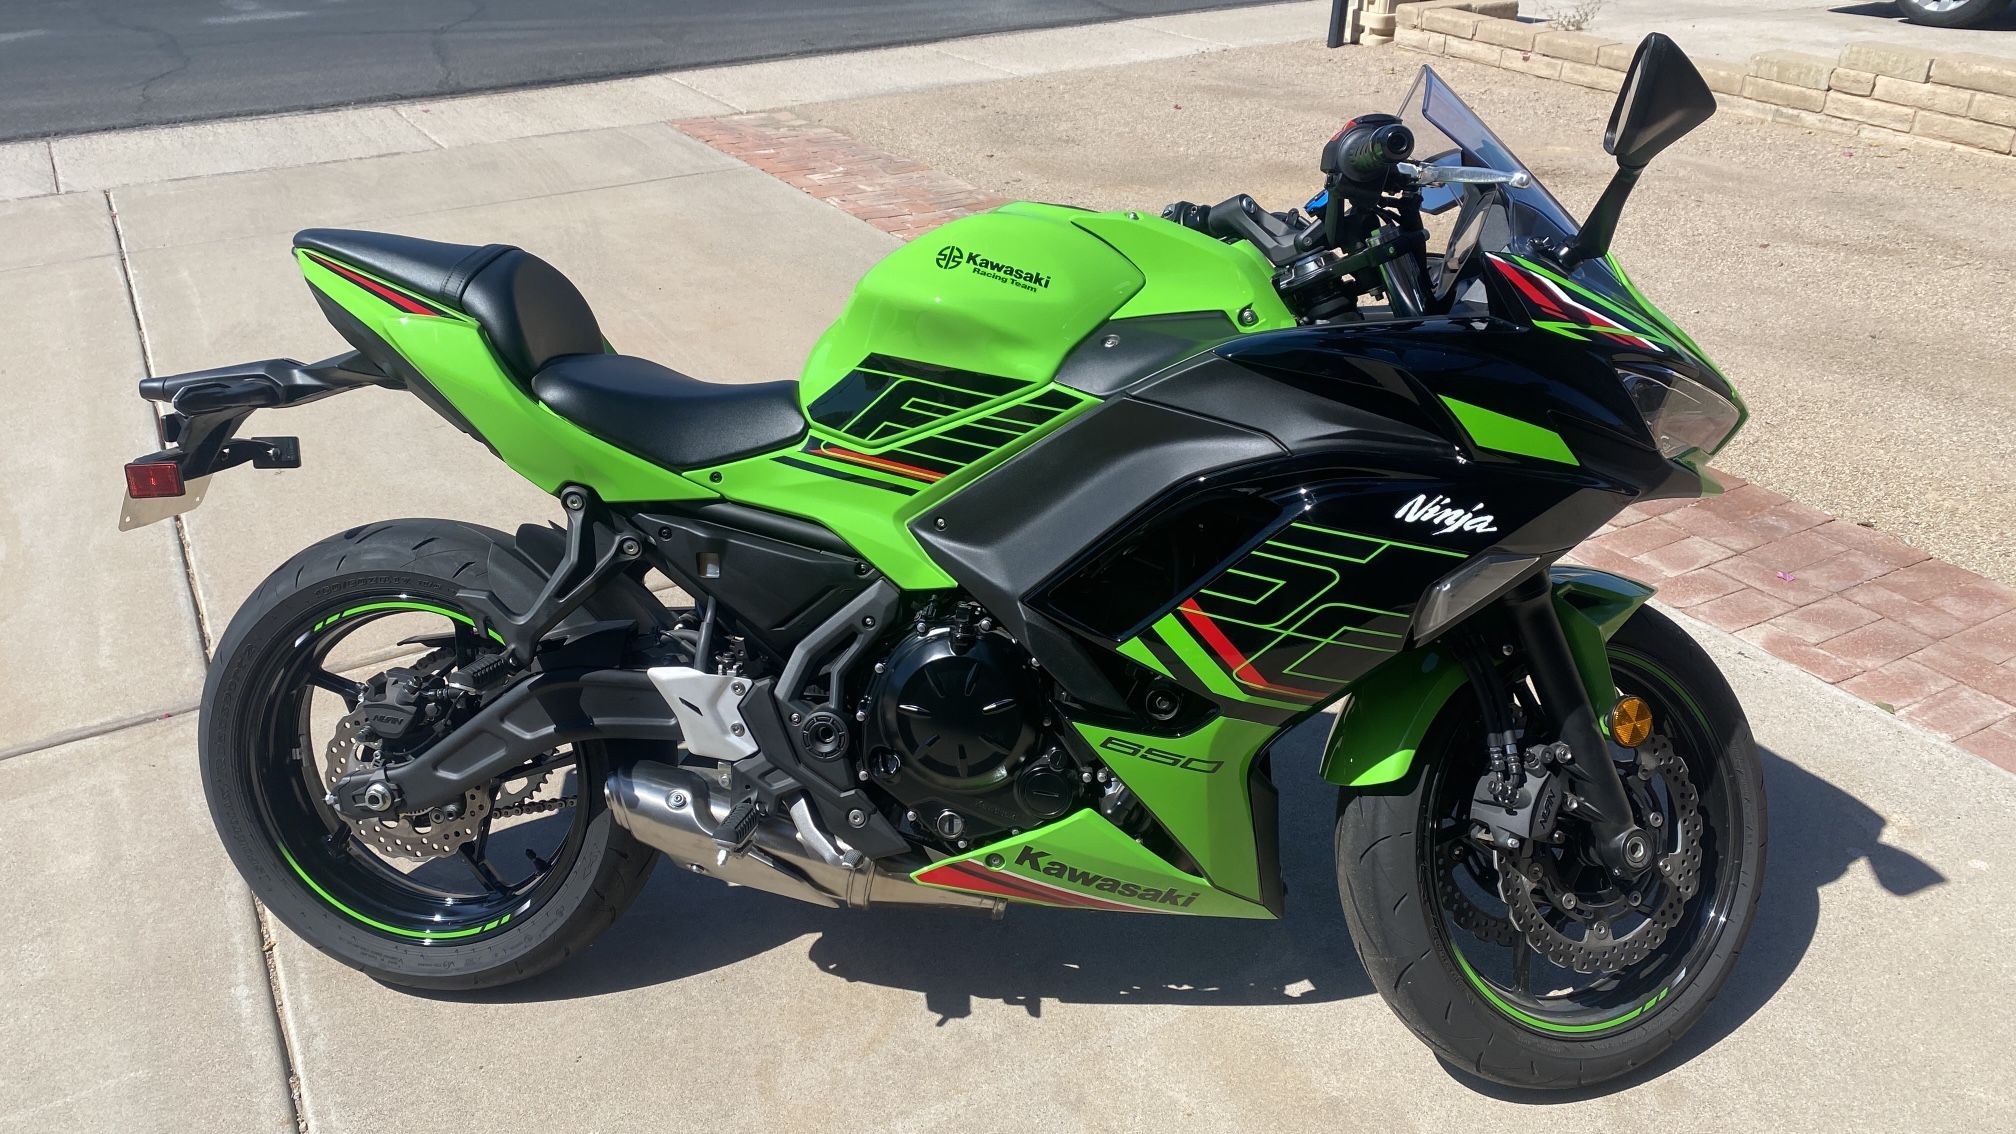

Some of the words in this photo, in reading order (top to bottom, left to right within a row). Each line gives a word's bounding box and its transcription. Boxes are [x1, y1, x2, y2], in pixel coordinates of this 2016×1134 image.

[965, 251, 1052, 289] Kawasaki
[972, 267, 1008, 284] Racing
[1010, 278, 1037, 293] Team
[1394, 494, 1498, 536] Ninja
[1099, 736, 1225, 774] 650
[1014, 845, 1200, 908] Kawasaki
